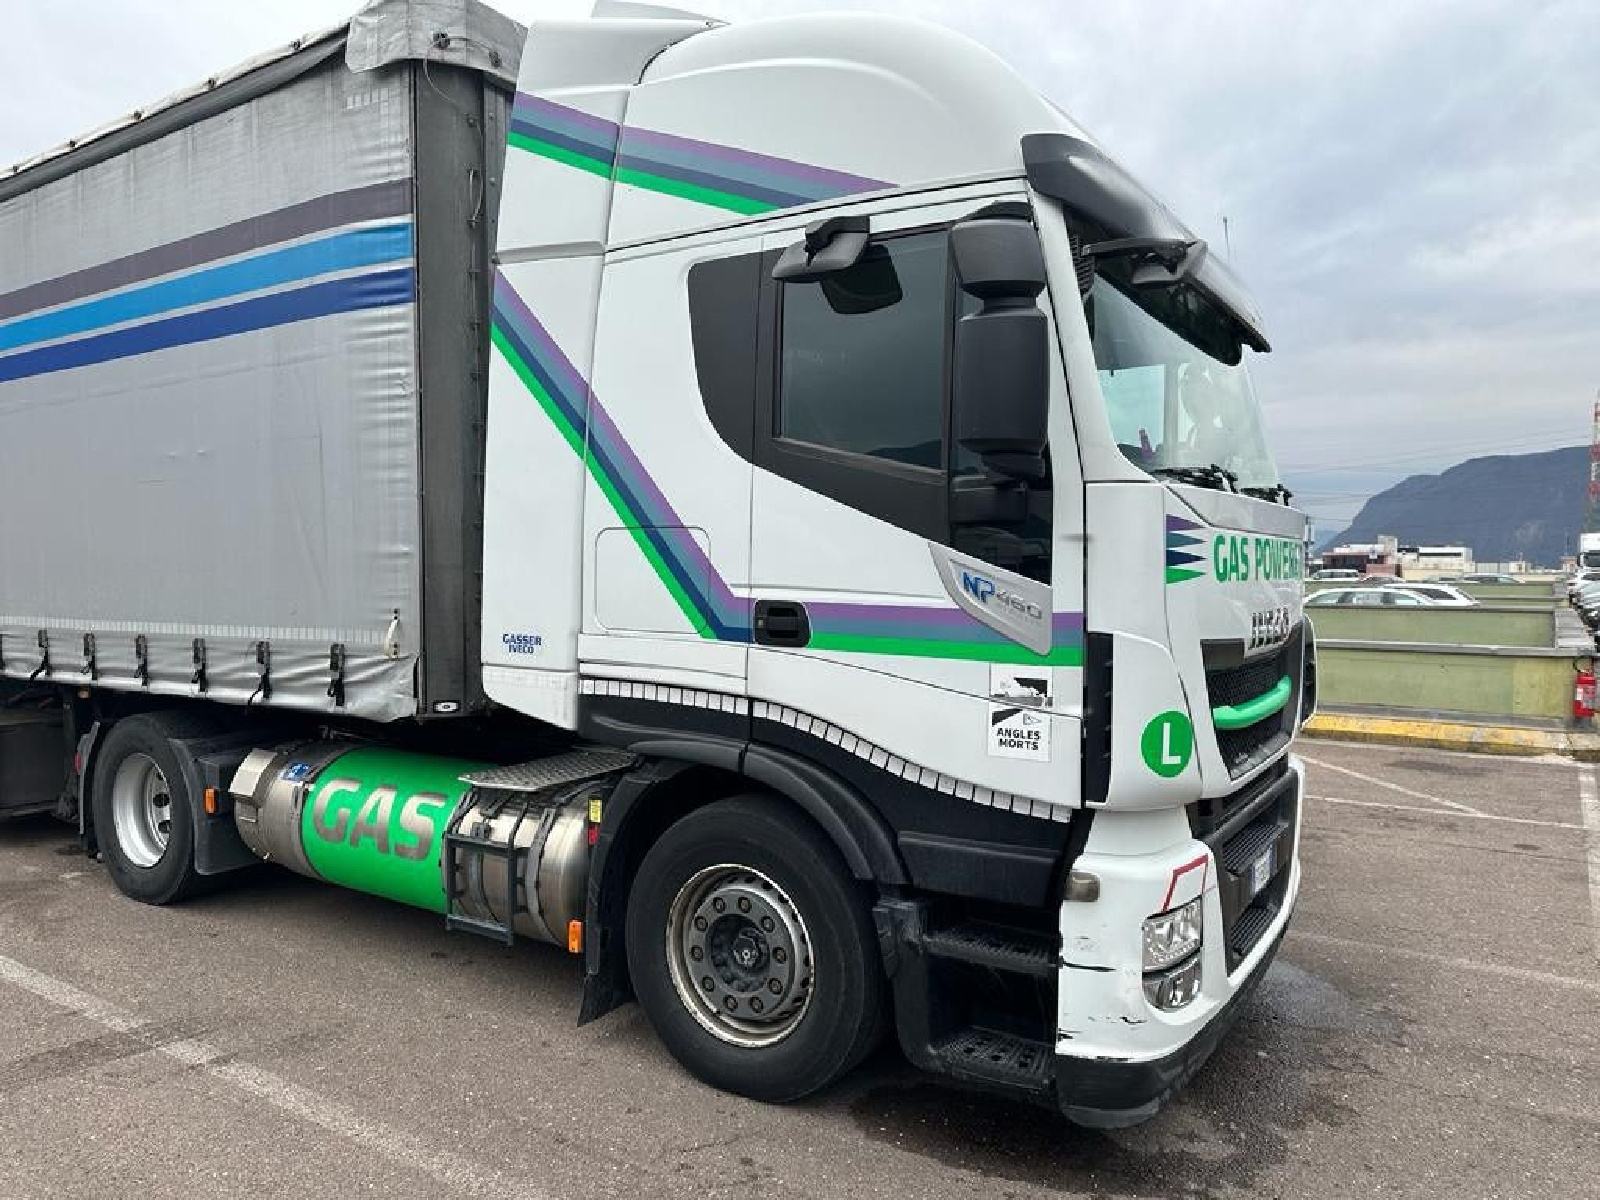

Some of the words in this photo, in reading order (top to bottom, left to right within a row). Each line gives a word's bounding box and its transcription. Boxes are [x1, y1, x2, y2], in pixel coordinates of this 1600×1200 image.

[1213, 535, 1249, 583] GAS
[963, 571, 995, 603] NP
[502, 633, 542, 645] GASSER
[508, 644, 535, 654] IVECO
[996, 727, 1042, 741] ANGLES
[998, 738, 1040, 751] MORTS
[1161, 722, 1182, 765] L
[312, 777, 447, 862] GAS
